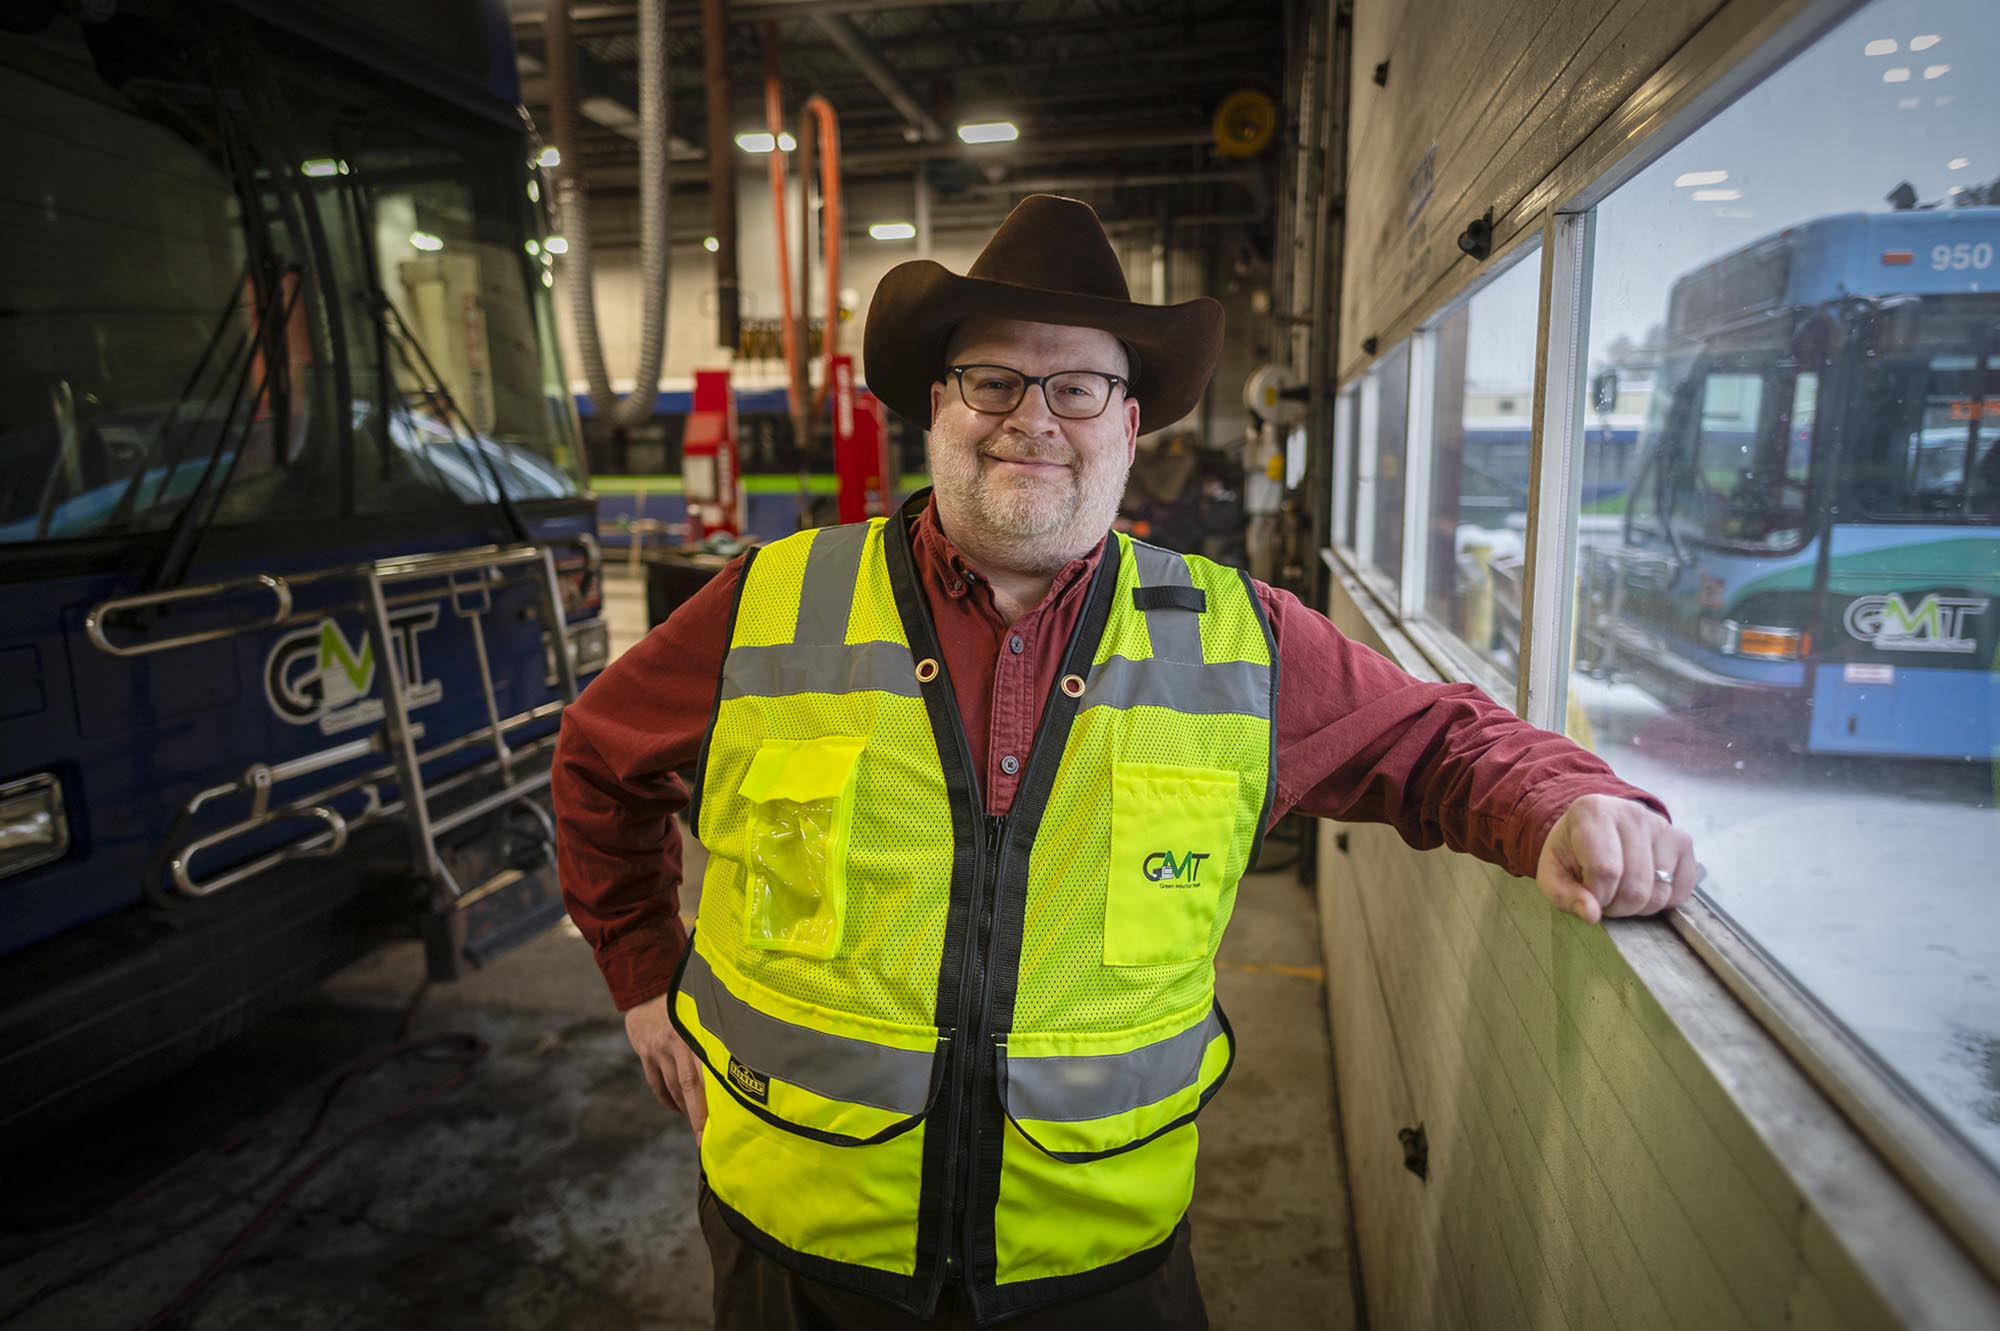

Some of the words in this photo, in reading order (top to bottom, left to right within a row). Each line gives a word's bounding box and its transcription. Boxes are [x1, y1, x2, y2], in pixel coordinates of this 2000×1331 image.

[1931, 243, 1992, 271] 950
[1844, 594, 1988, 641] GMT
[1143, 850, 1210, 882] GMT
